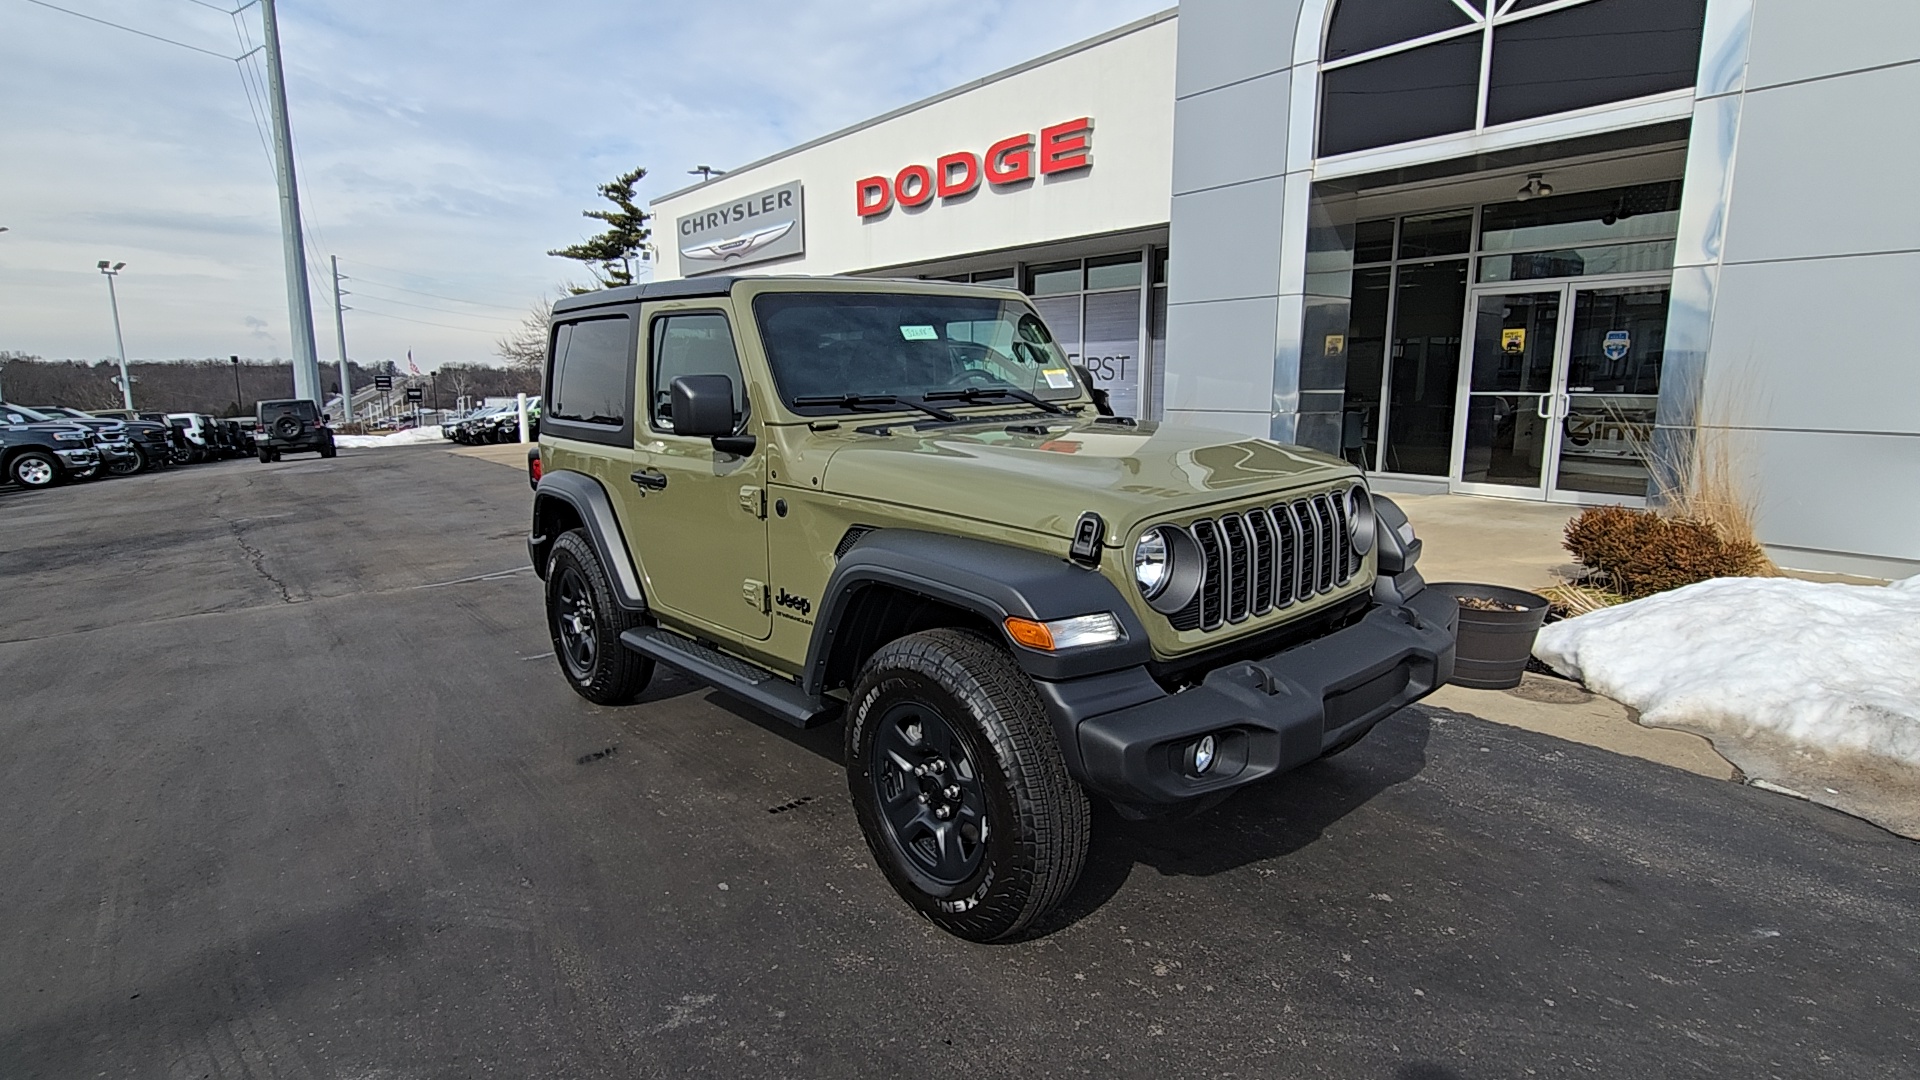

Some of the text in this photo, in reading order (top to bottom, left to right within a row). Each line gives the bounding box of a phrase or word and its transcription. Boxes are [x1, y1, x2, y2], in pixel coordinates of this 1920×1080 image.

[857, 117, 1092, 217] DODGE
[681, 190, 793, 236] CHRYSLER
[775, 587, 811, 616] Jeep
[941, 866, 995, 913] NEXEN
